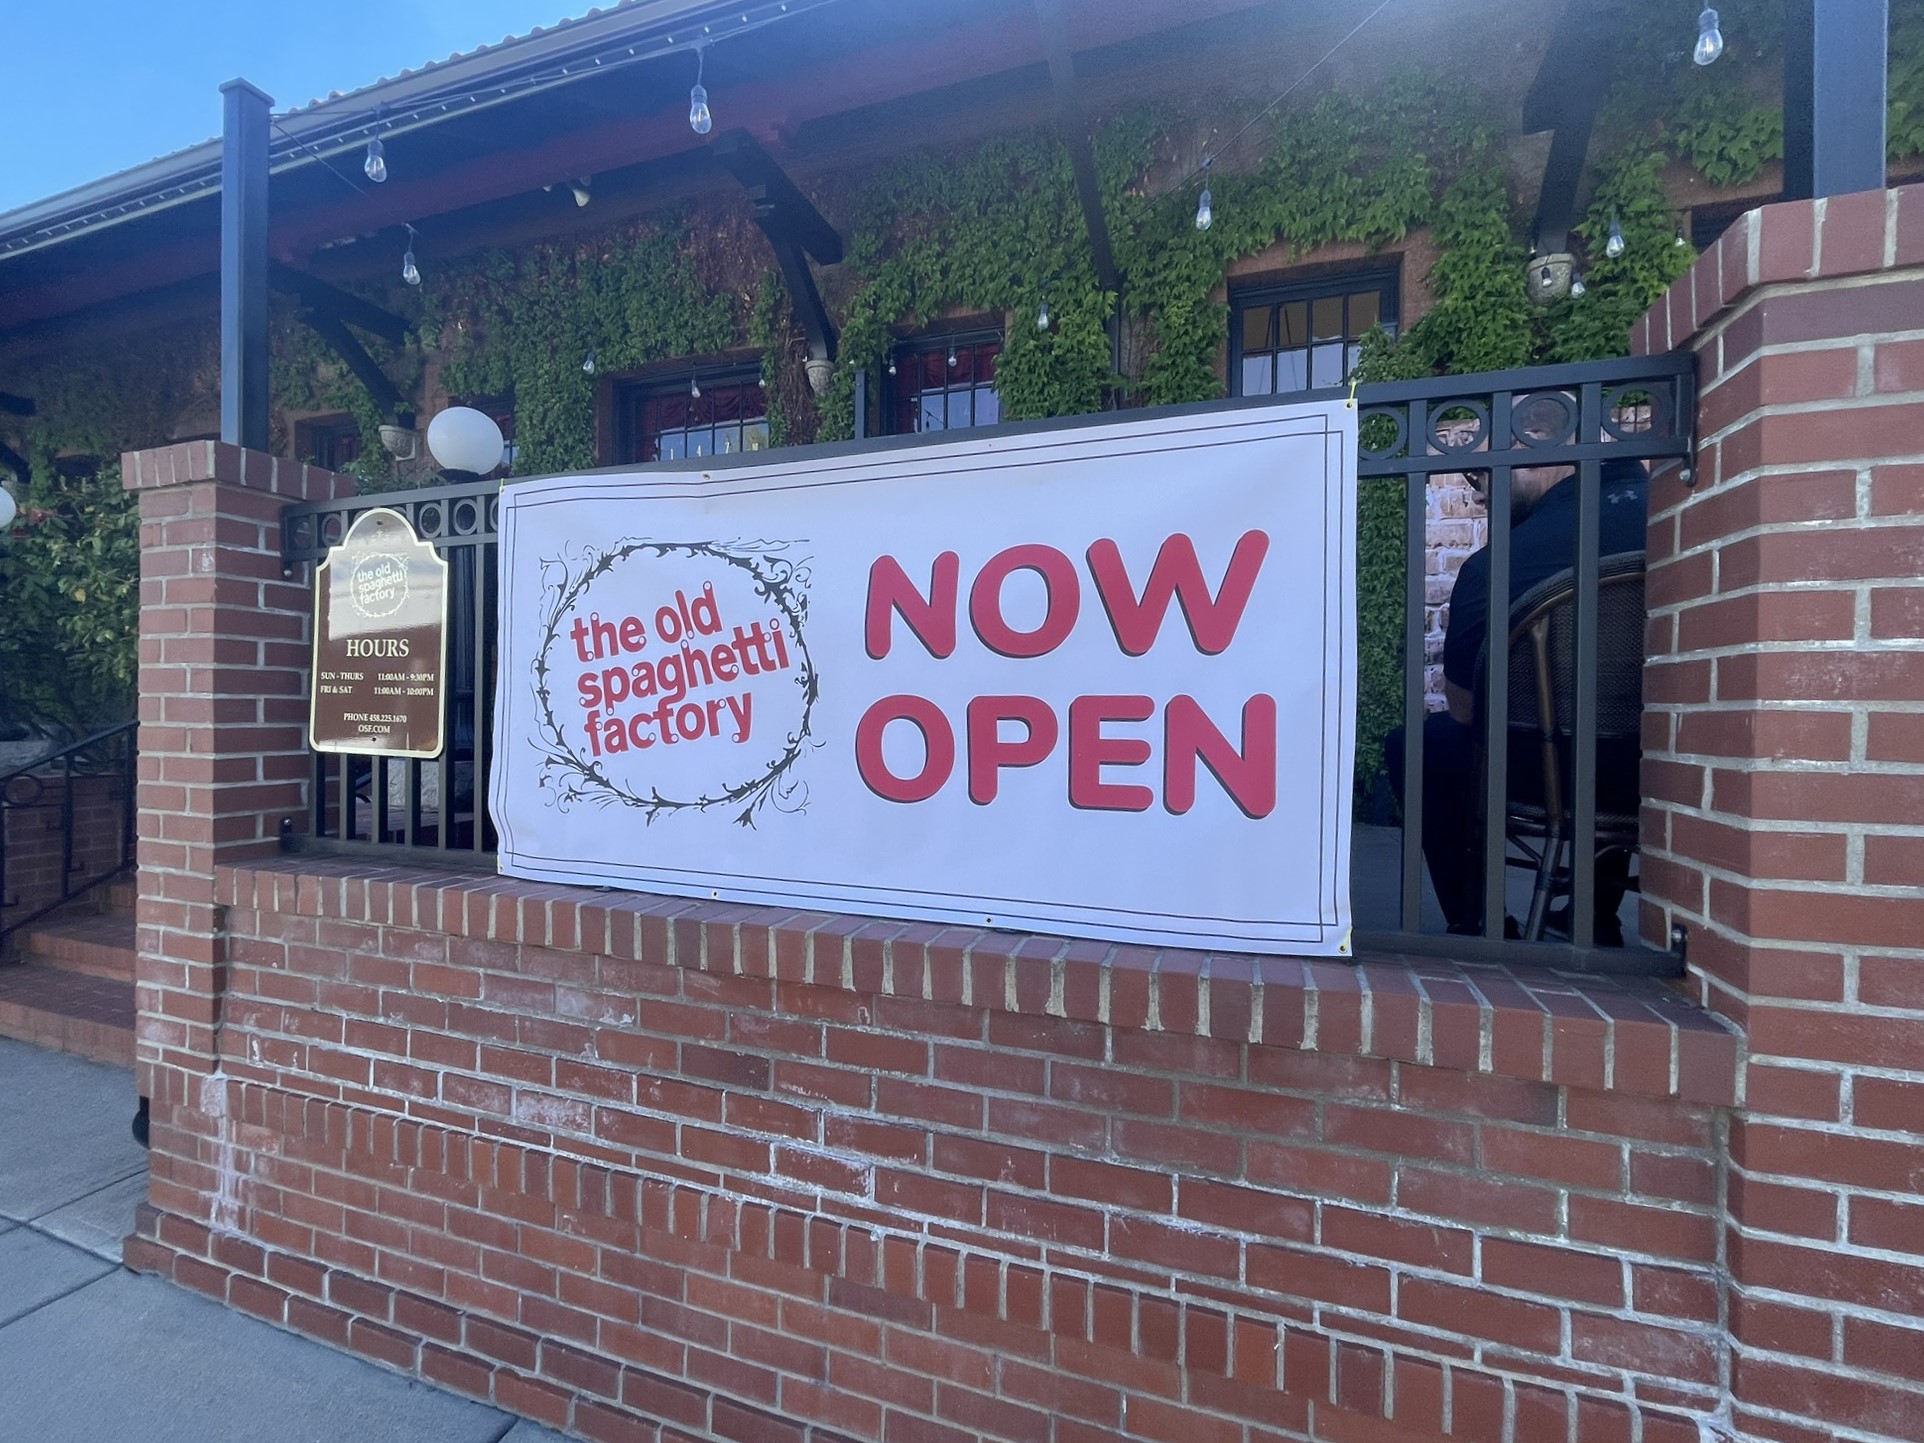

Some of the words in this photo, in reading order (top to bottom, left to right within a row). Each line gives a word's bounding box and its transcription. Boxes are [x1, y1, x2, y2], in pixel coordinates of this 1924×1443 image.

[357, 569, 374, 583] the
[375, 561, 391, 578] old
[358, 569, 403, 594] spaghetti
[359, 586, 395, 606] factory
[865, 529, 1269, 659] NOW
[570, 612, 647, 663] the
[655, 580, 722, 643] old
[345, 638, 410, 658] HOURS
[320, 671, 336, 681] SUN
[340, 671, 365, 681] THURS
[377, 672, 406, 682] 11:00AM
[409, 673, 435, 682] 9:30PM
[577, 617, 790, 716] spaghetti
[320, 685, 332, 694] FRI
[338, 686, 353, 695] SAT
[373, 686, 402, 696] 11:00AM
[406, 687, 434, 696] 10:00PM
[343, 712, 369, 722] PHONE
[583, 692, 752, 757] factory
[357, 724, 391, 734] OSF.COM
[856, 693, 1277, 819] OPEN
